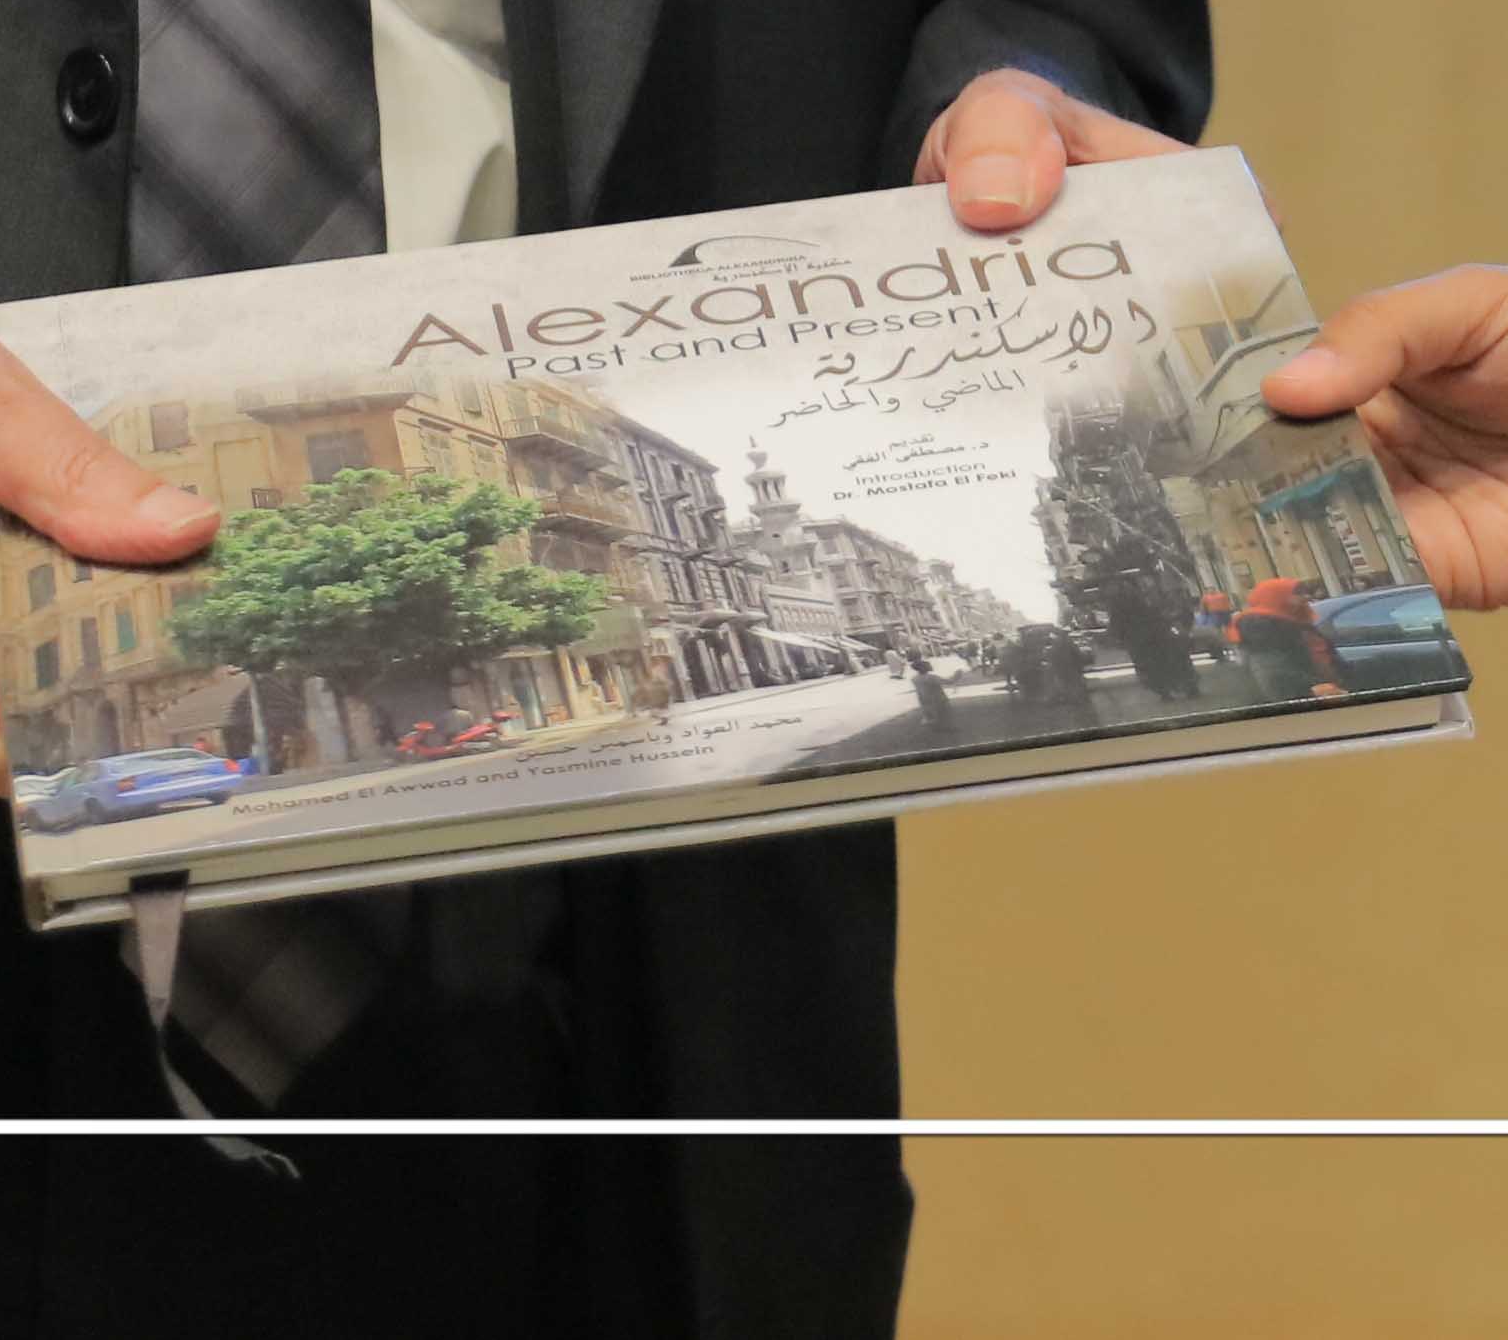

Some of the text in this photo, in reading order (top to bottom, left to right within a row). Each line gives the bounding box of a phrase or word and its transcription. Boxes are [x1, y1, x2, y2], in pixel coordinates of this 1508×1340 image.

[391, 237, 1134, 367] Alexandria
[506, 296, 1002, 380] Past and Present
[766, 369, 1027, 429] الماضي والحاضر
[832, 468, 1018, 502] Dr. Mostafa El Feki
[855, 461, 987, 487] Introduction
[232, 744, 716, 817] Mohamed El Awwad and Yasmine Hussein
